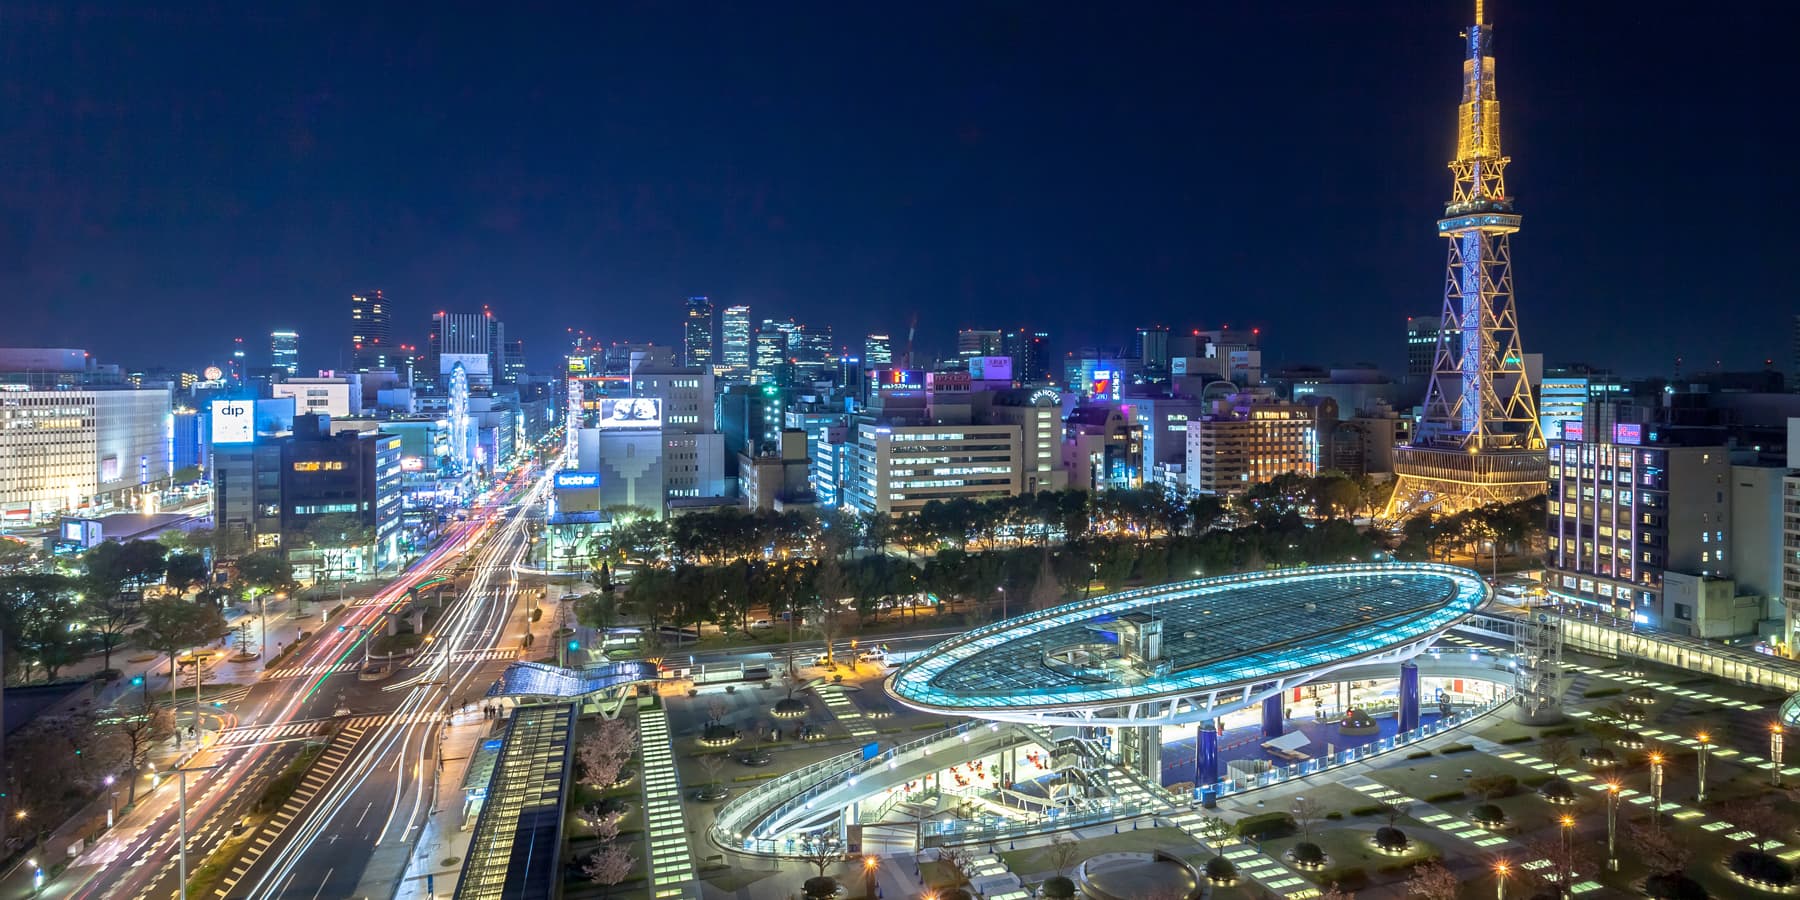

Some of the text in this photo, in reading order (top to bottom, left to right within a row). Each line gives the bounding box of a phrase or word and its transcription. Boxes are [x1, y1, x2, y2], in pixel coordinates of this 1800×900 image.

[1031, 389, 1061, 404] APA HOTEL
[221, 404, 244, 417] dip
[559, 475, 596, 486] brother
